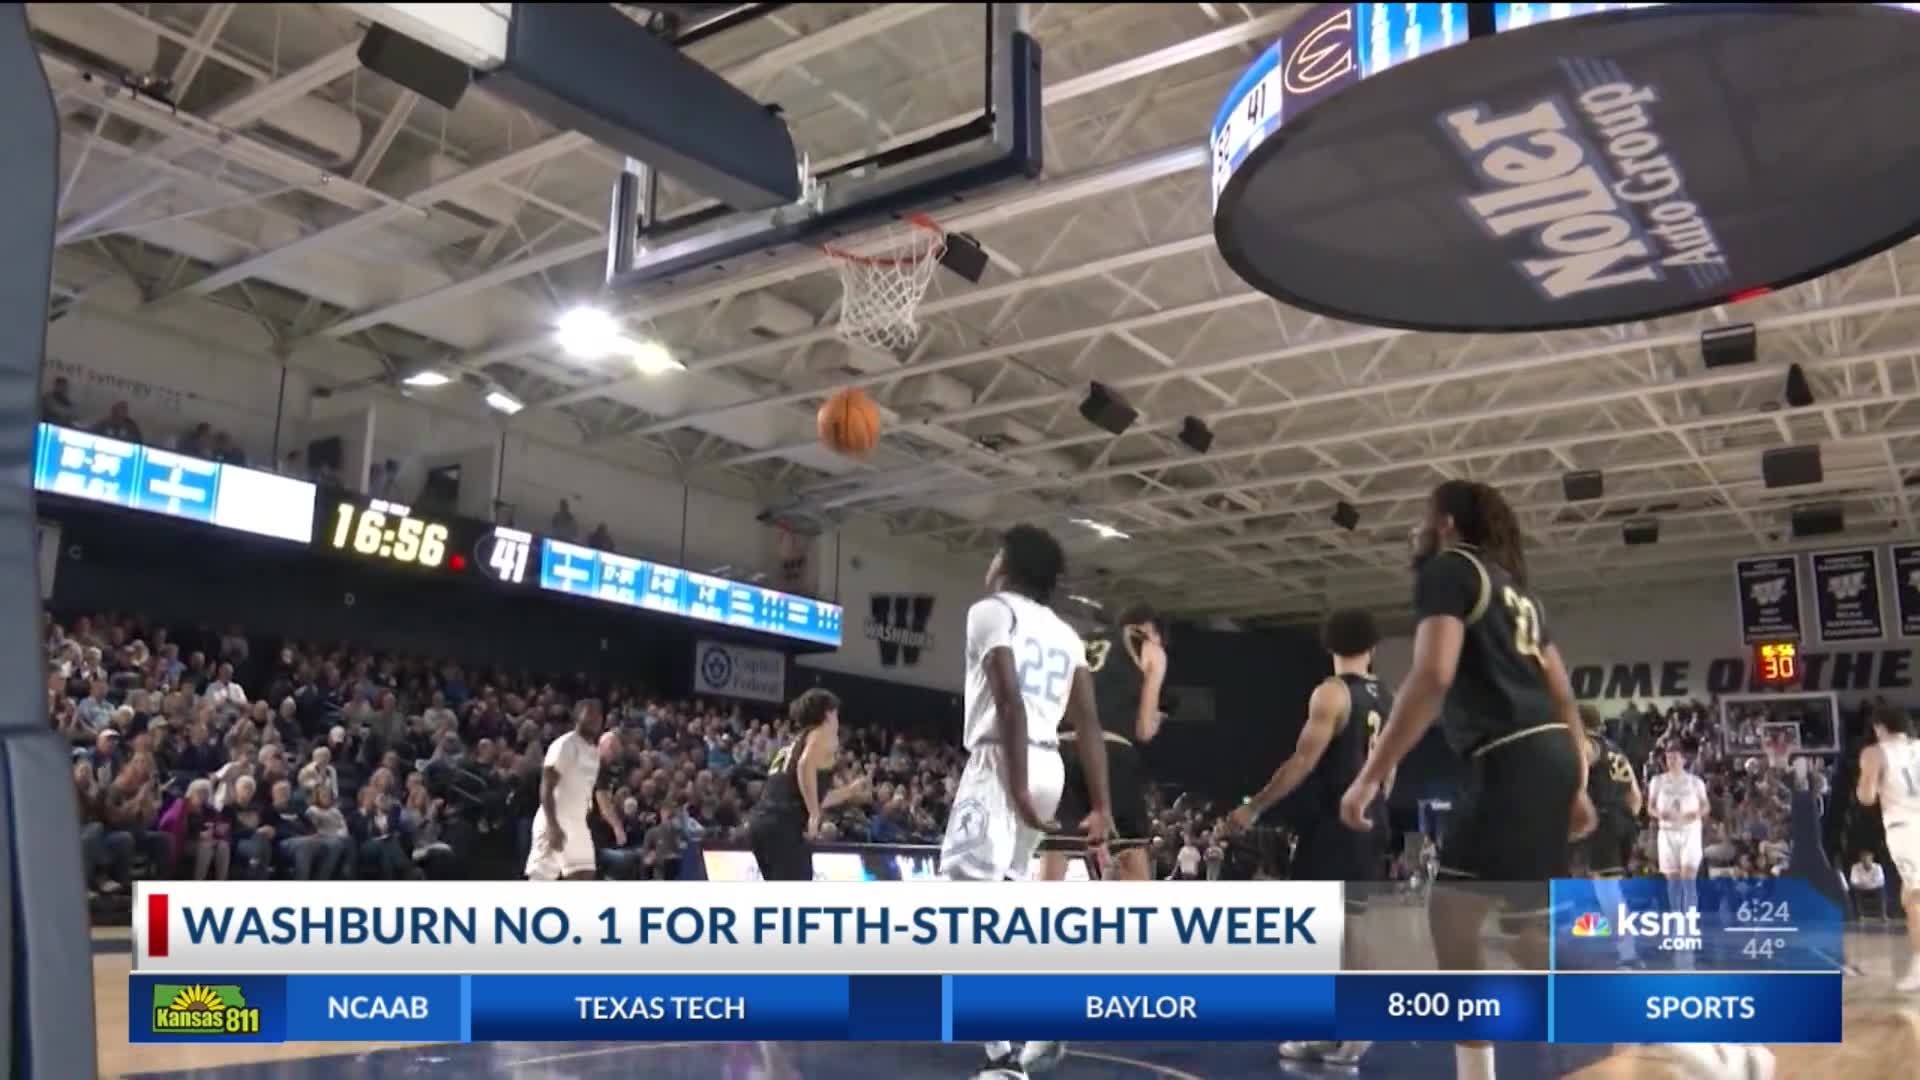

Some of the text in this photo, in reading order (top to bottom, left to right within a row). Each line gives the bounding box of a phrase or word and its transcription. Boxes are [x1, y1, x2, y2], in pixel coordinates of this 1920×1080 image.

[1447, 102, 1658, 298] Noller
[1579, 83, 1726, 268] Auto Group
[333, 502, 449, 568] 16:56
[490, 537, 530, 584] 41
[1018, 637, 1070, 704] 22
[1763, 655, 1795, 680] 30
[1801, 649, 1912, 692] THE
